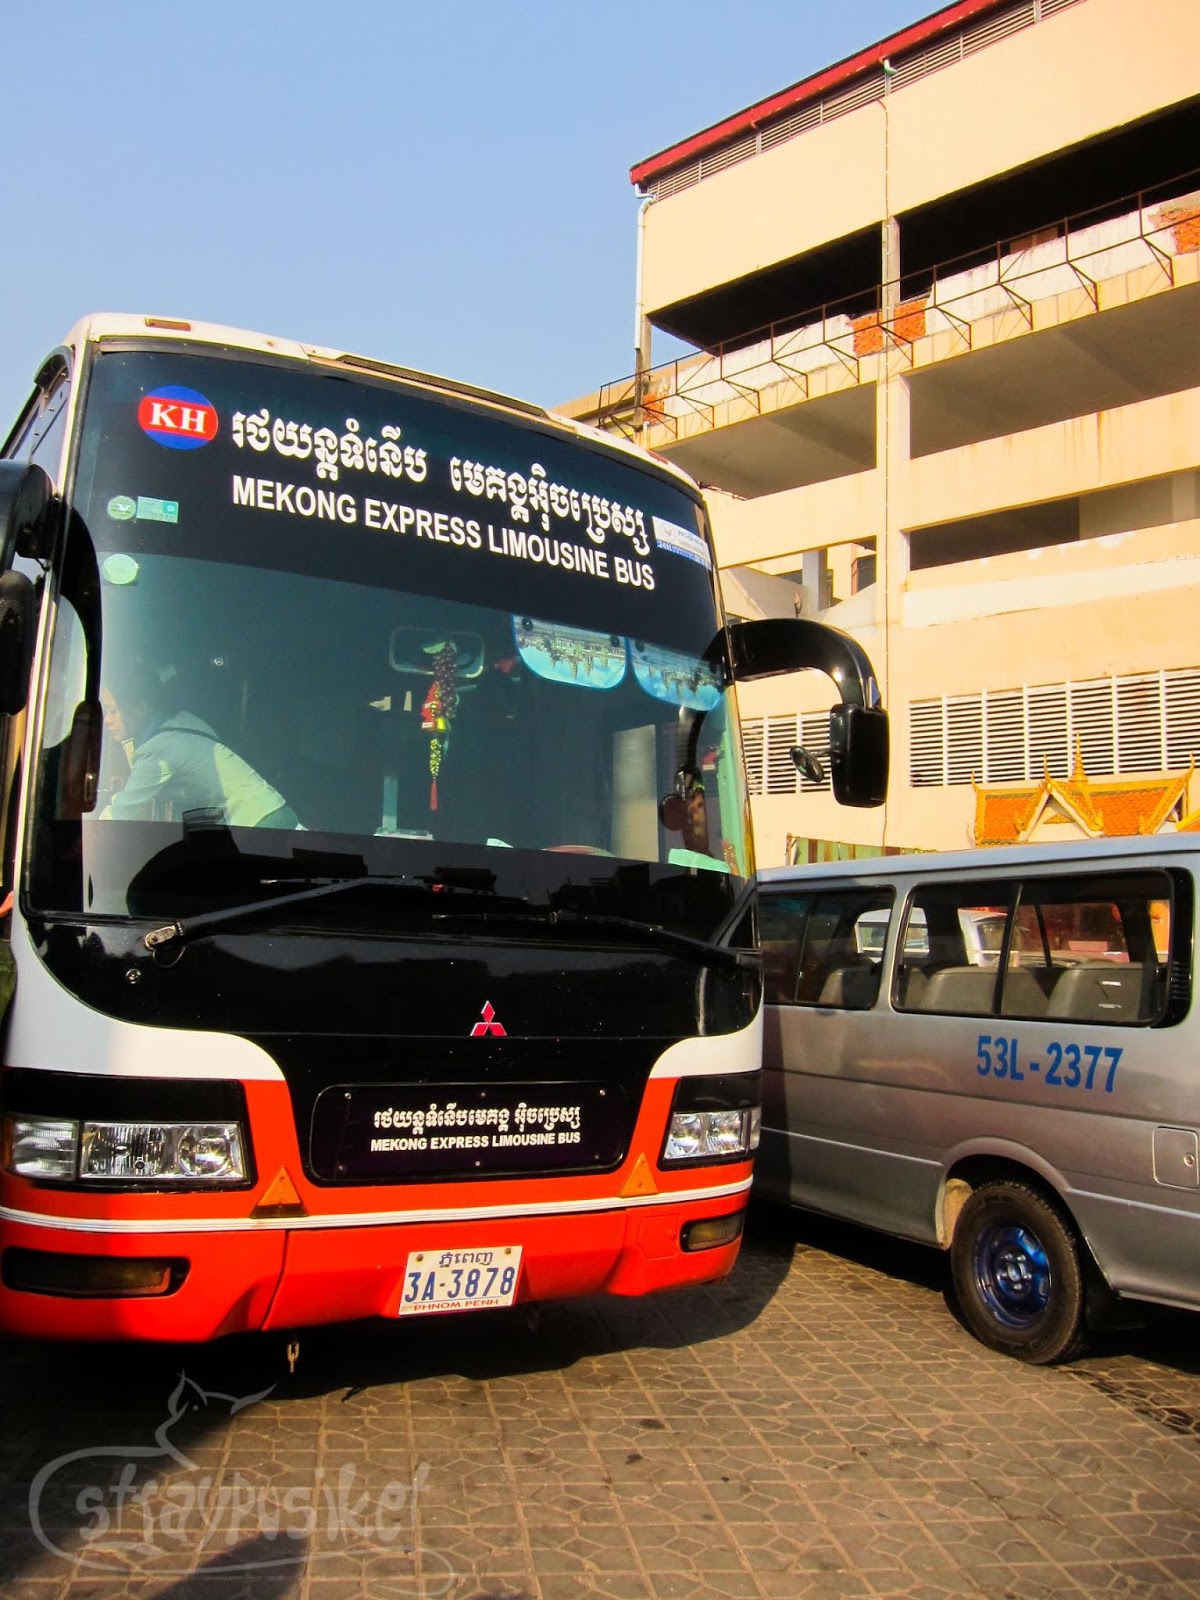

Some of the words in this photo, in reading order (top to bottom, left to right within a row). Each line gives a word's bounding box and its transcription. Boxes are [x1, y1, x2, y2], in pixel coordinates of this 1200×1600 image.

[149, 402, 207, 434] KH
[233, 475, 357, 524] MEKONG
[365, 498, 481, 549] EXPRESS
[488, 524, 609, 579] LIMOUSINE
[614, 556, 655, 591] BUS
[371, 1138, 427, 1152] MEKONG
[430, 1136, 489, 1150] EXPRESS
[492, 1133, 555, 1148] LIMOUSINE
[558, 1132, 581, 1145] BUS
[404, 1266, 516, 1303] 3A-3878
[414, 1302, 461, 1312] PHNOM
[465, 1299, 499, 1307] PENH
